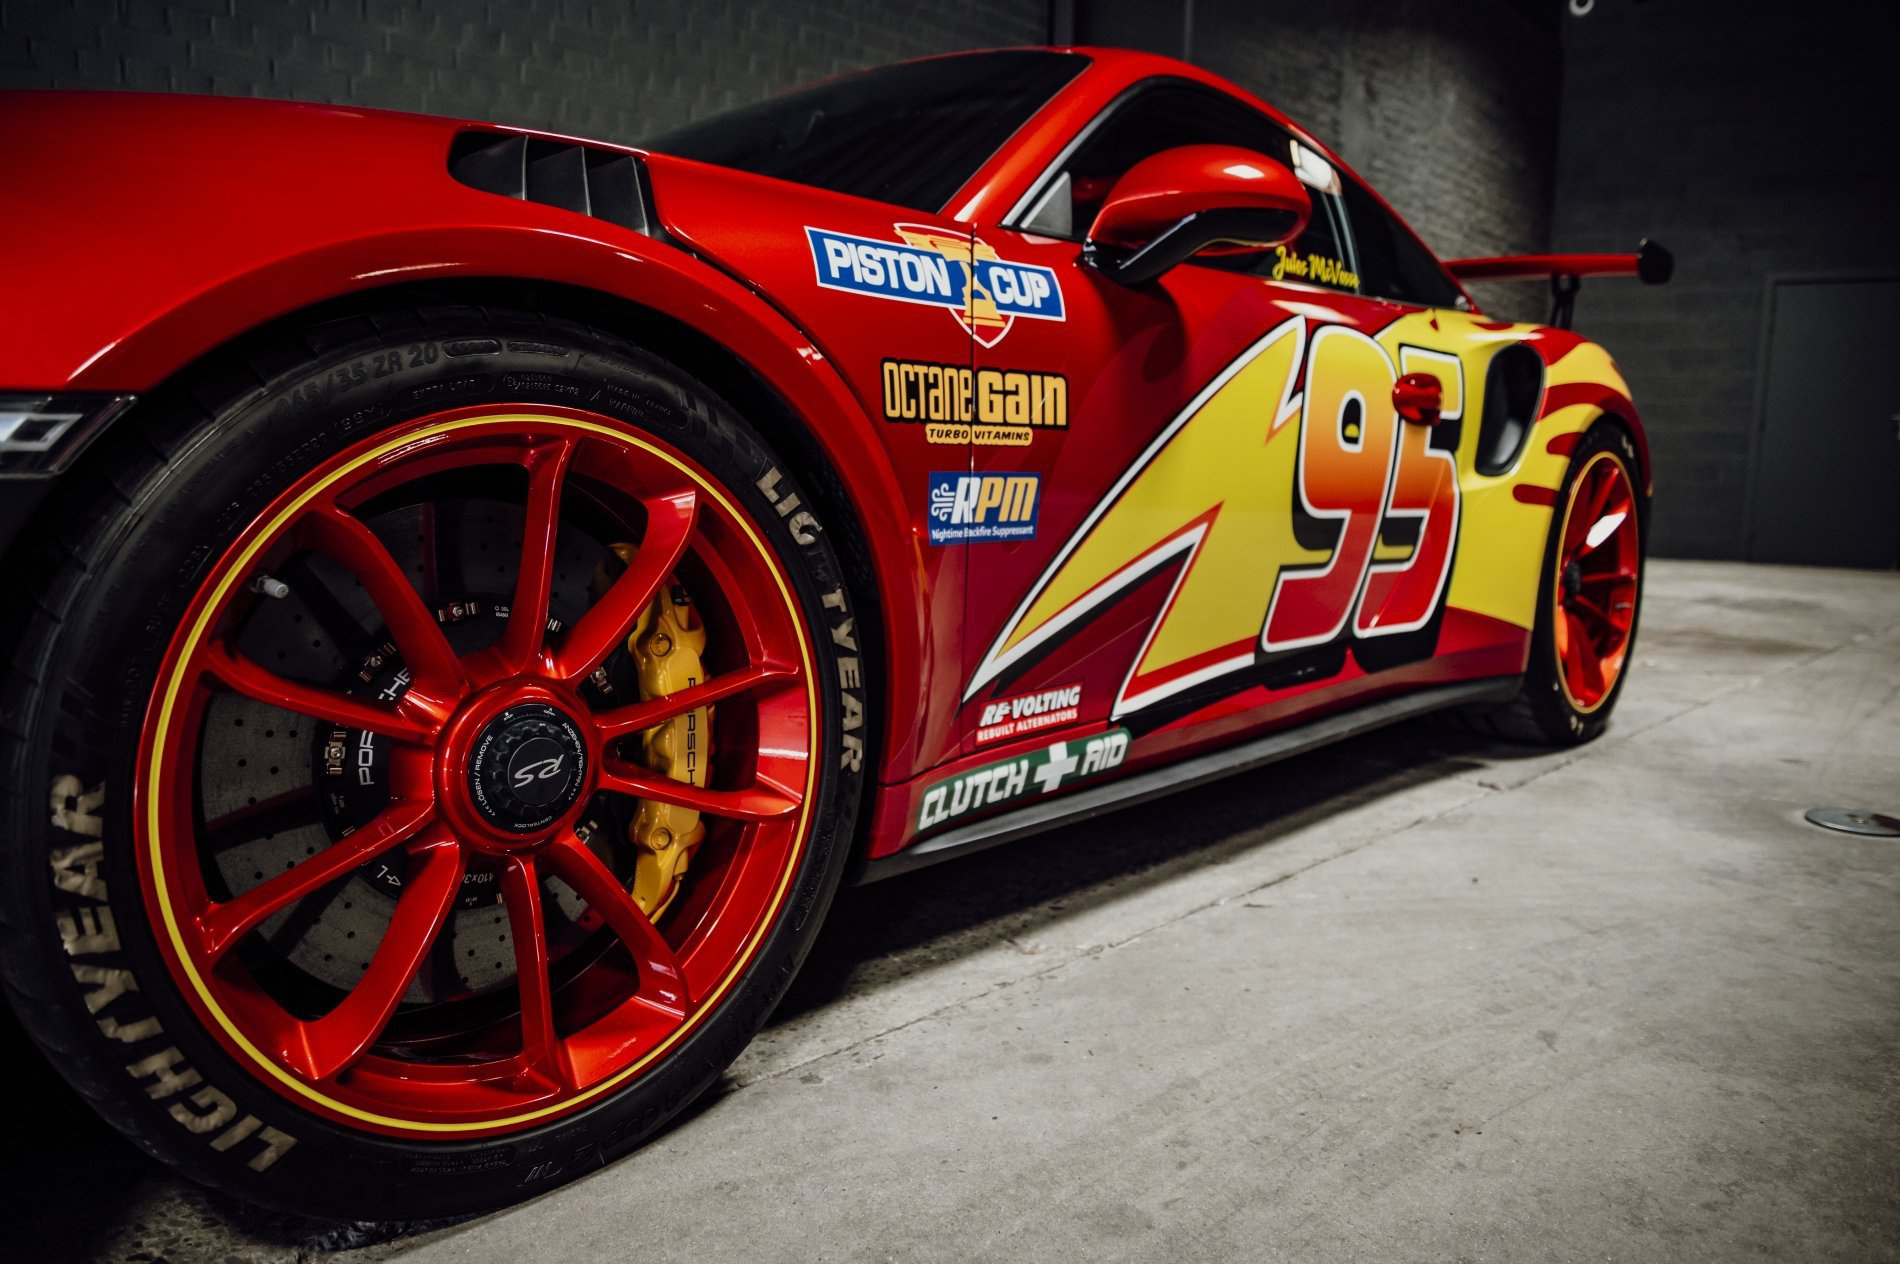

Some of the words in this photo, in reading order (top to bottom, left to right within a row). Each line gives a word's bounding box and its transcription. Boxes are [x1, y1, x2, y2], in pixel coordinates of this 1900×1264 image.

[823, 237, 952, 297] PISTON
[988, 266, 1051, 308] CUP
[408, 341, 440, 368] 20
[928, 428, 969, 440] TURBO
[974, 429, 1030, 441] VITAMINS
[950, 477, 1038, 524] RPM
[1262, 325, 1464, 652] 95
[932, 529, 963, 542] Nightime
[964, 527, 992, 539] Backfire
[992, 525, 1034, 539] Suppressant
[755, 466, 864, 775] LIGTYEAR
[977, 722, 1014, 743] REBUILT
[1016, 708, 1079, 731] ALTERNATORS
[980, 685, 1082, 727] RE-VOLTING
[475, 734, 494, 771] REMOVE
[514, 754, 564, 788] RS
[918, 758, 1030, 831] CLUTCH
[1080, 732, 1129, 776] AID
[461, 872, 494, 884] 410x3
[50, 773, 298, 1173] LIGHTYEAR
